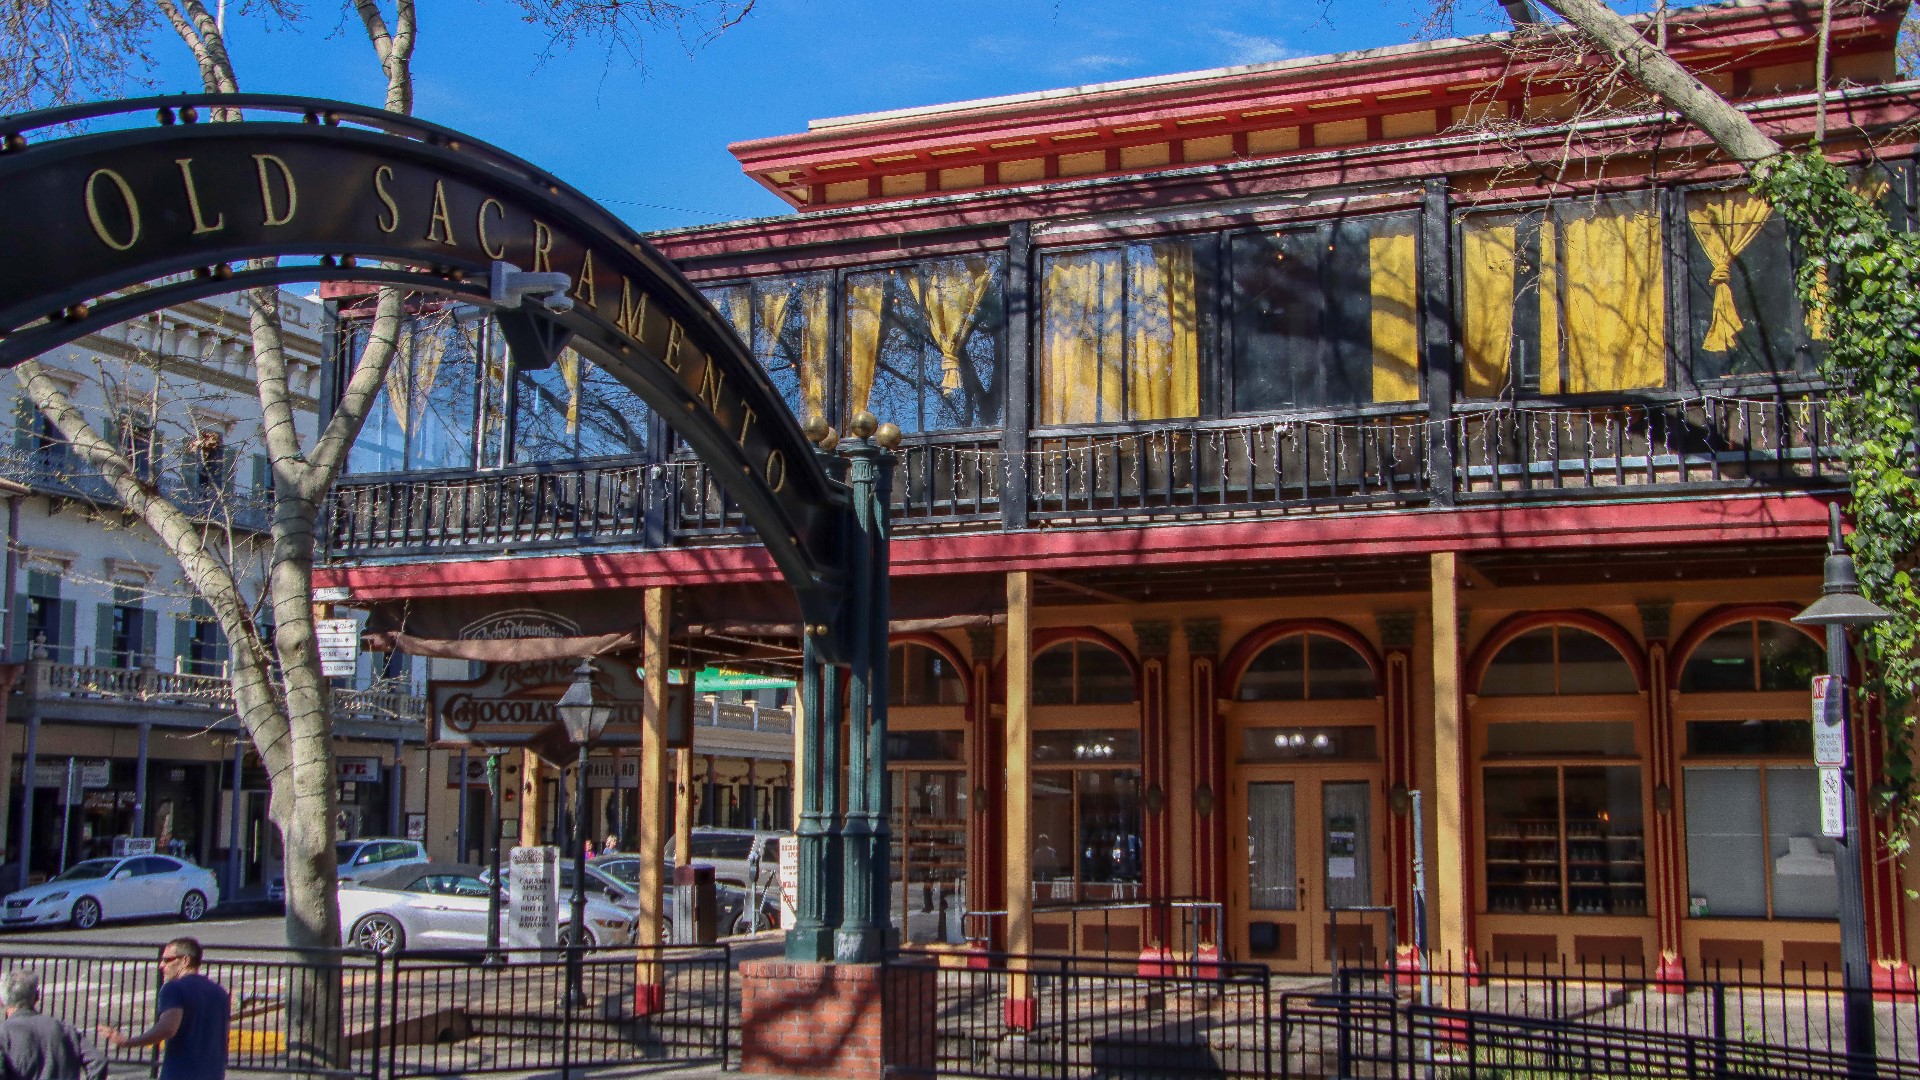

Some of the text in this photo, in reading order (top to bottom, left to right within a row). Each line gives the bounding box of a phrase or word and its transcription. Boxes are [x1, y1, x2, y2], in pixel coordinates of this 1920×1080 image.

[85, 154, 787, 493] OLD SACRAMENTO
[442, 693, 558, 733] CHOCOLAT
[587, 764, 635, 777] RAILYRD
